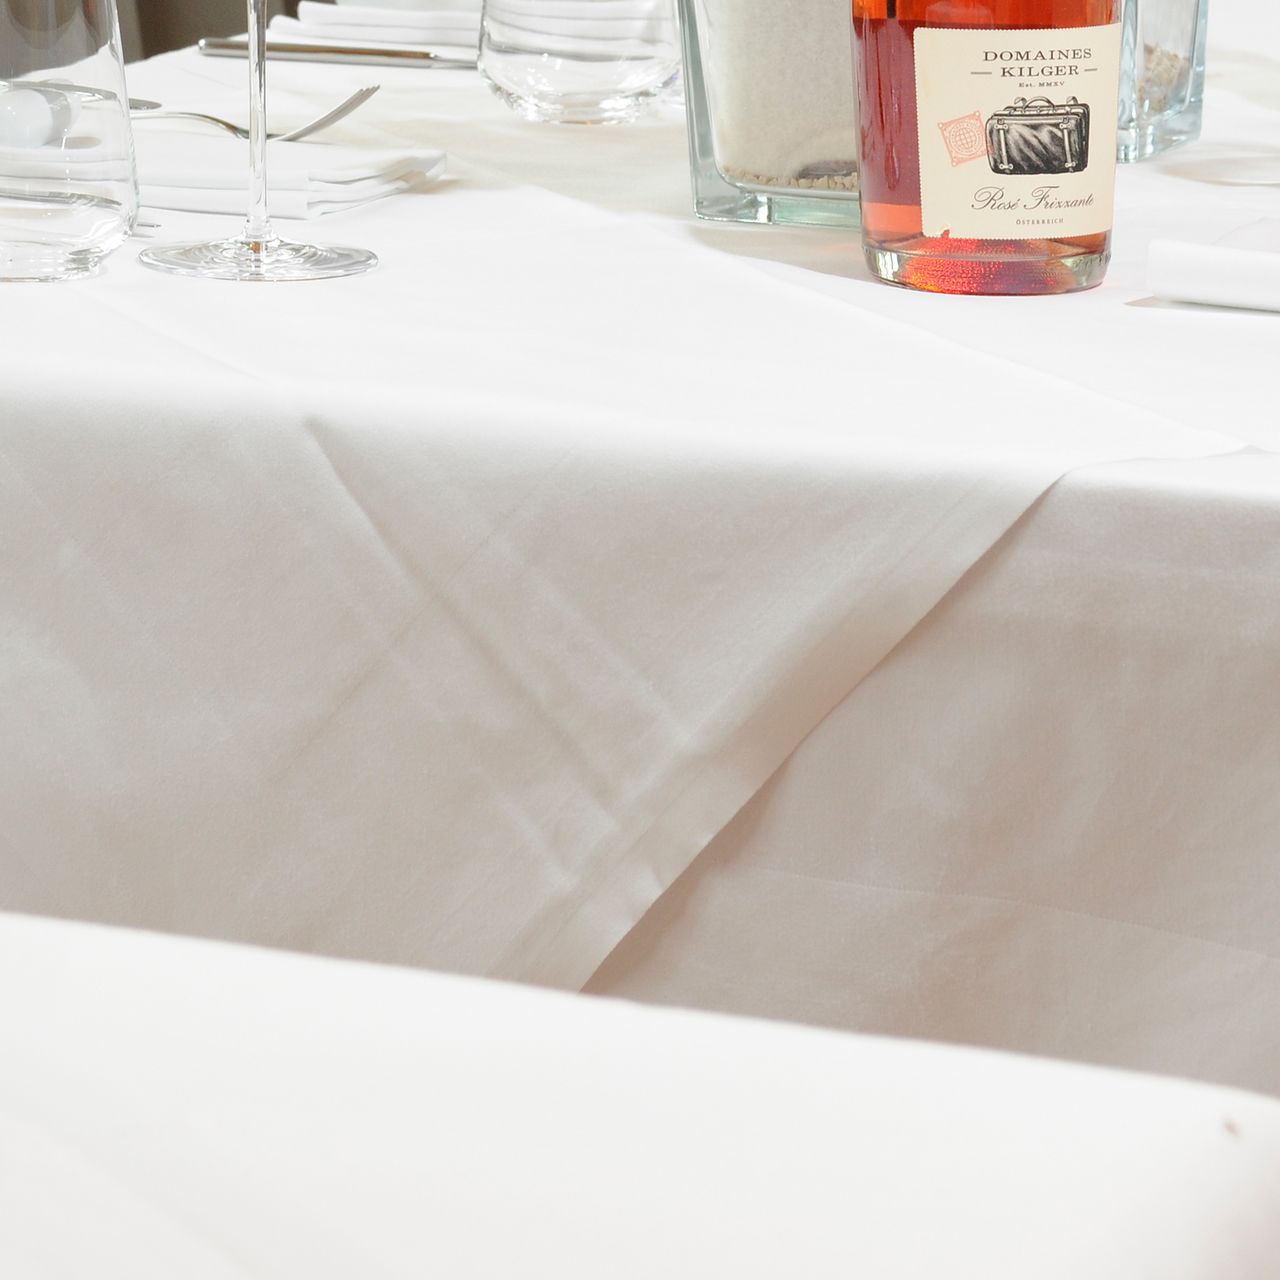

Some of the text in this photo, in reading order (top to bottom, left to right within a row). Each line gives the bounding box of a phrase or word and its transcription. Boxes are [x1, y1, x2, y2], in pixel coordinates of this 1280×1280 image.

[983, 48, 1093, 62] DOMAINES
[1000, 64, 1080, 78] KILGER
[1038, 80, 1065, 88] MMXV
[970, 185, 1095, 211] Rosé Frizzante
[1015, 217, 1064, 225] ÖSTERREICH
